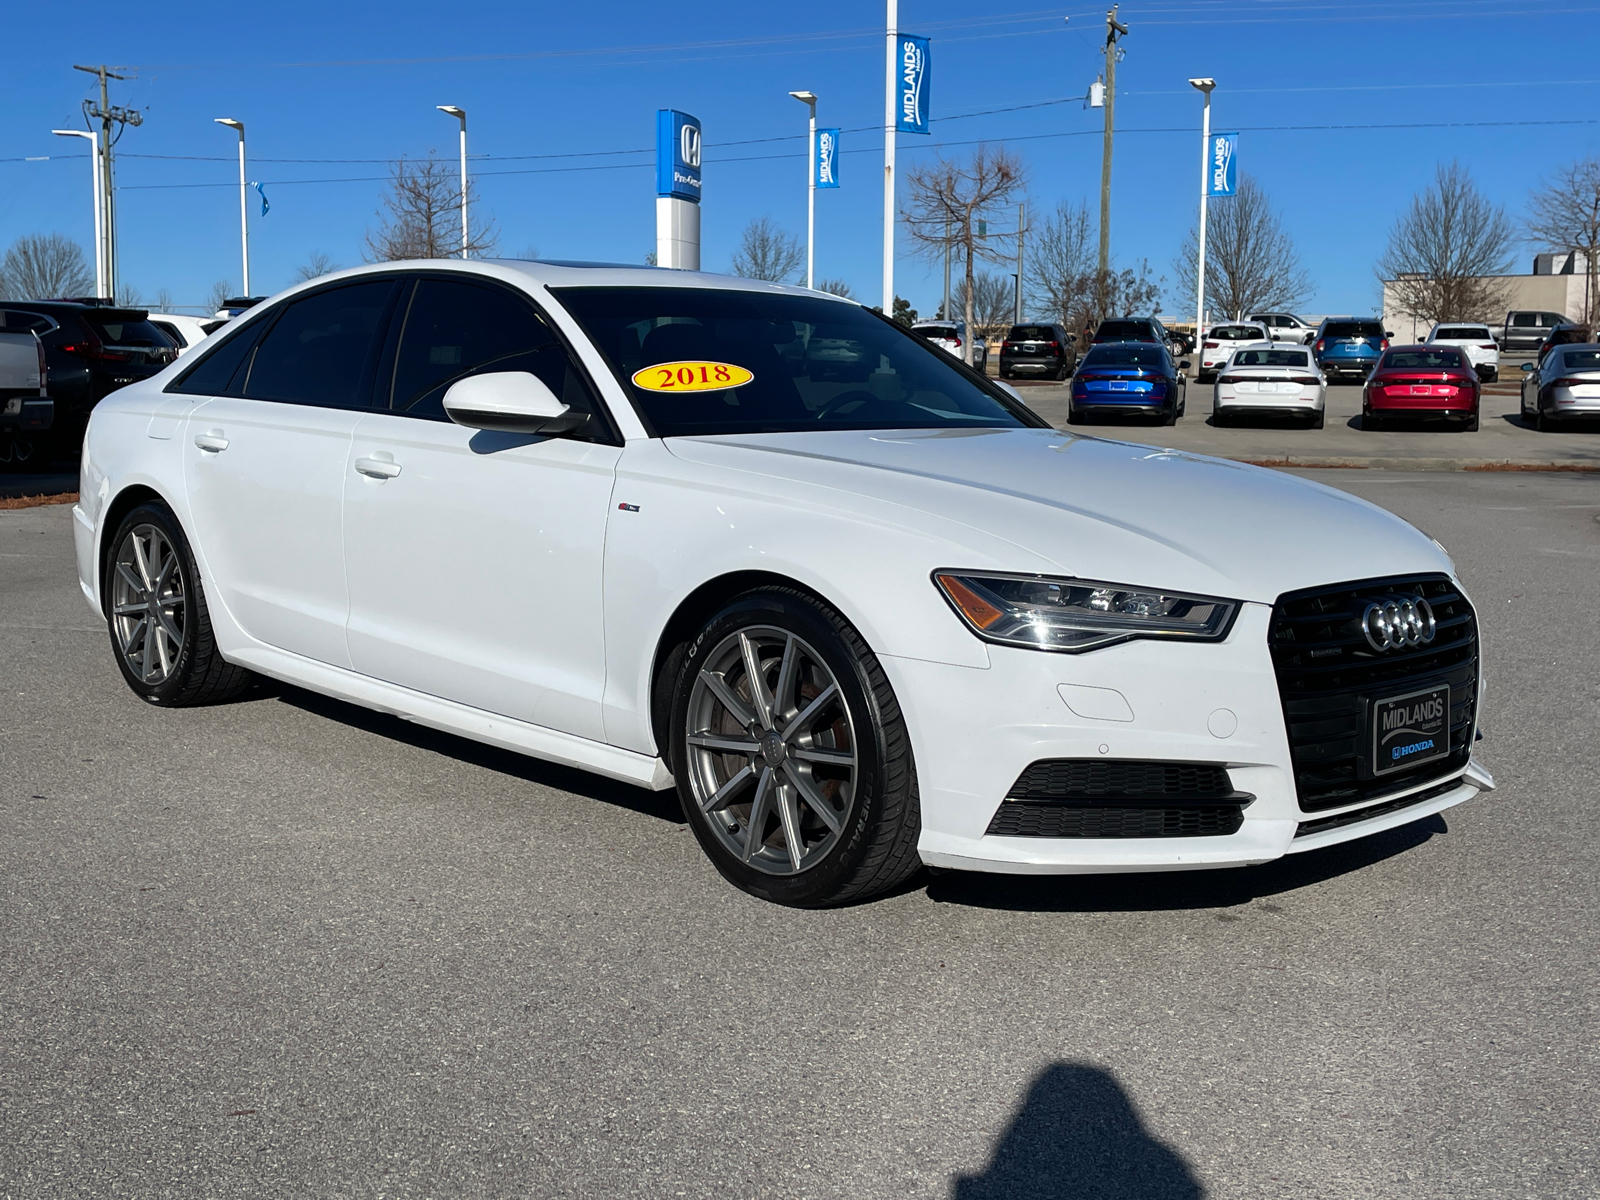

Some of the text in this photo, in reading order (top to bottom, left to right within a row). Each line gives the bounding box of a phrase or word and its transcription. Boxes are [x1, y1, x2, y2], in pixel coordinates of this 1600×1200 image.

[904, 42, 915, 123] MIDLANDS
[820, 133, 829, 183] MIDLANDS
[1214, 138, 1225, 191] MIDLANDS
[657, 365, 731, 388] 2018
[1383, 698, 1443, 731] MIDLANDS
[1402, 739, 1434, 756] HONDA
